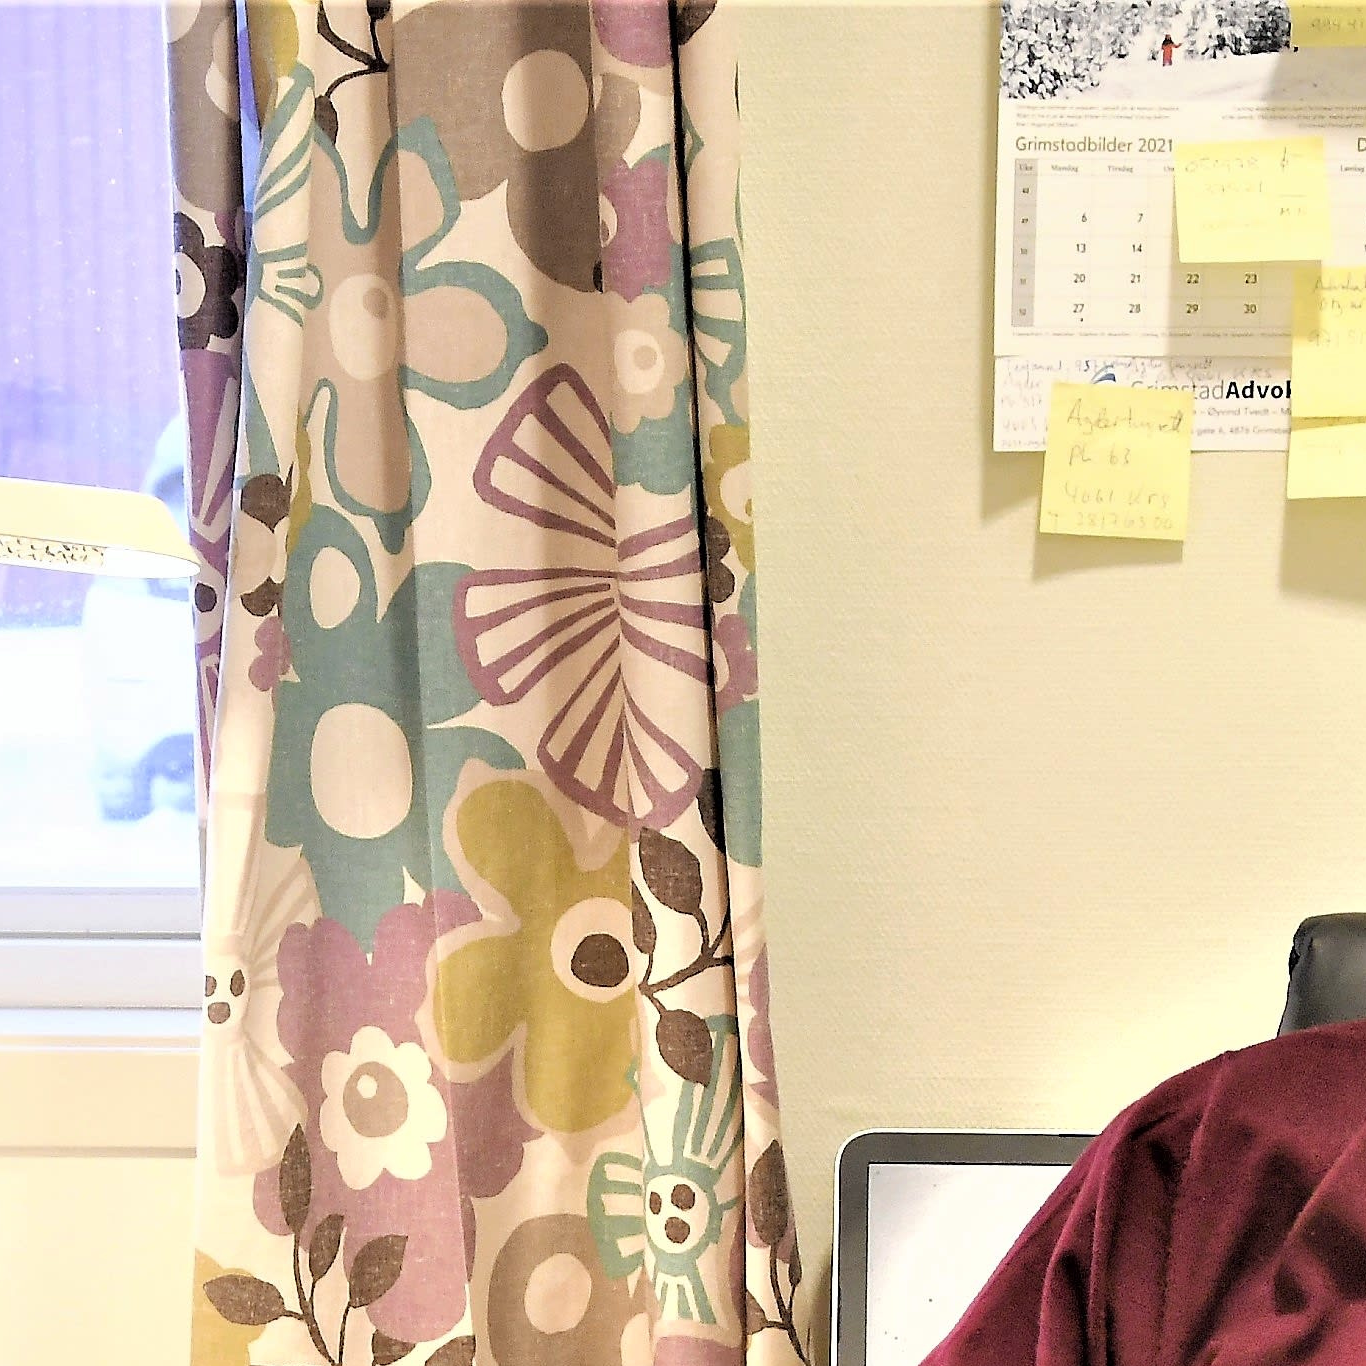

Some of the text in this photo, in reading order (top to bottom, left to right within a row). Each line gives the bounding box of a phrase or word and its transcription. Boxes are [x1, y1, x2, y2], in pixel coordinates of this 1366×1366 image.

[1015, 136, 1173, 153] Grimstadbilder 2021
[1081, 212, 1088, 223] 6
[1138, 212, 1144, 222] 7
[1076, 243, 1087, 253] 13
[1132, 243, 1143, 253] 14
[1073, 273, 1086, 284] 20
[1130, 273, 1141, 284] 21
[1186, 273, 1200, 284] 22
[1244, 273, 1257, 284] 23
[1073, 303, 1085, 314] 27
[1128, 303, 1141, 314] 28
[1185, 303, 1199, 314] 29
[1243, 303, 1257, 314] 30
